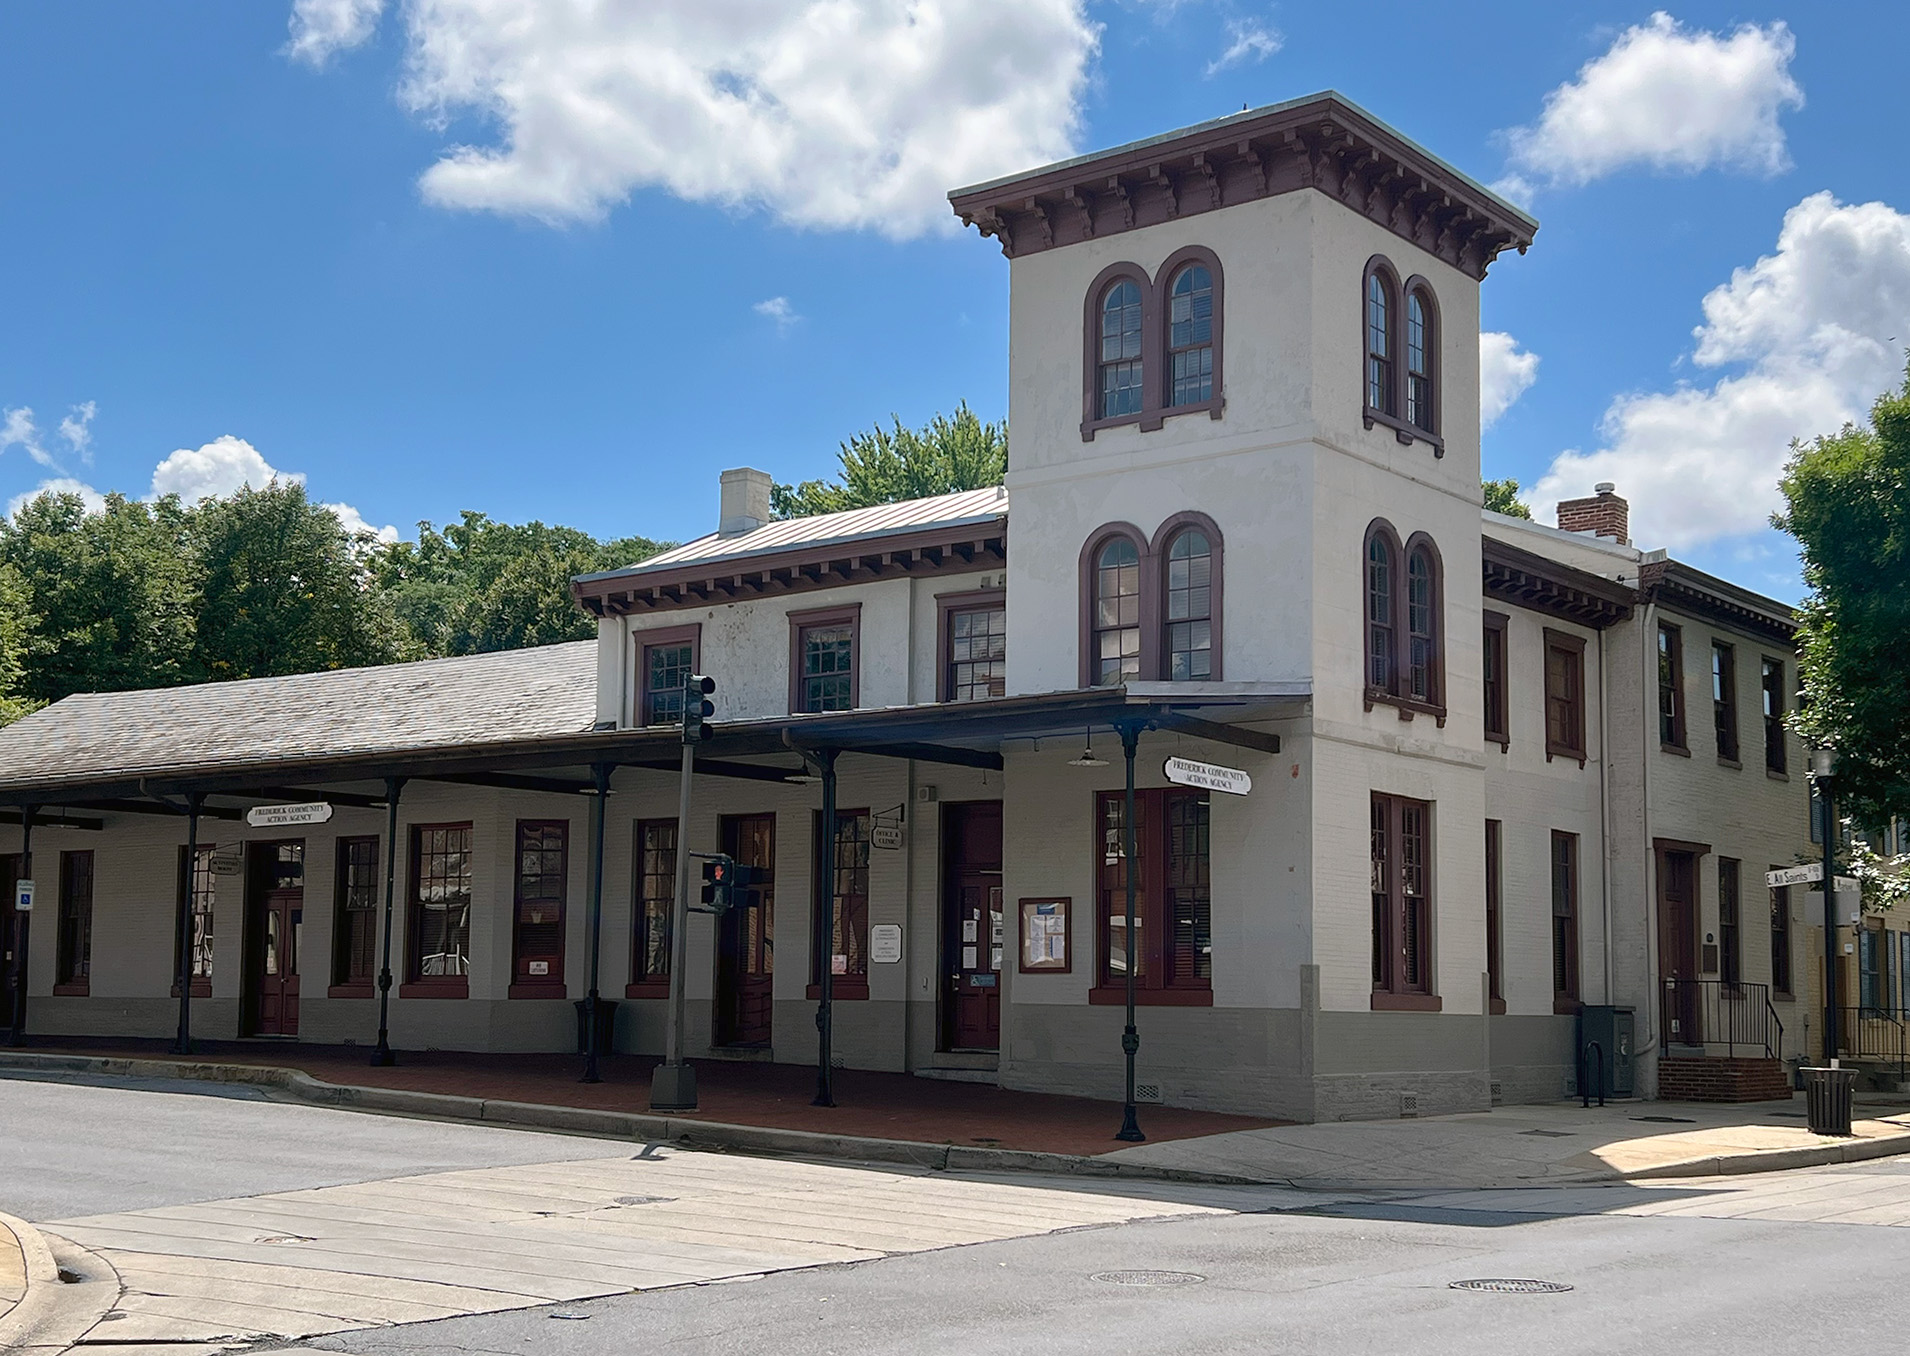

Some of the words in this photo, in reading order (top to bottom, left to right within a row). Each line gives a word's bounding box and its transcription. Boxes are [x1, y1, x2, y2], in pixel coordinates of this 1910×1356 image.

[1173, 760, 1206, 774] FREDERICK
[1207, 767, 1244, 782] COMMUNITY
[1186, 774, 1208, 785] ACTION
[1210, 778, 1232, 790] AGENCY
[255, 807, 287, 816] FREDERICK
[288, 805, 324, 813] COMMUNITY
[267, 815, 287, 823] ACTION
[1774, 873, 1783, 885] All
[1784, 871, 1808, 884] Saints
